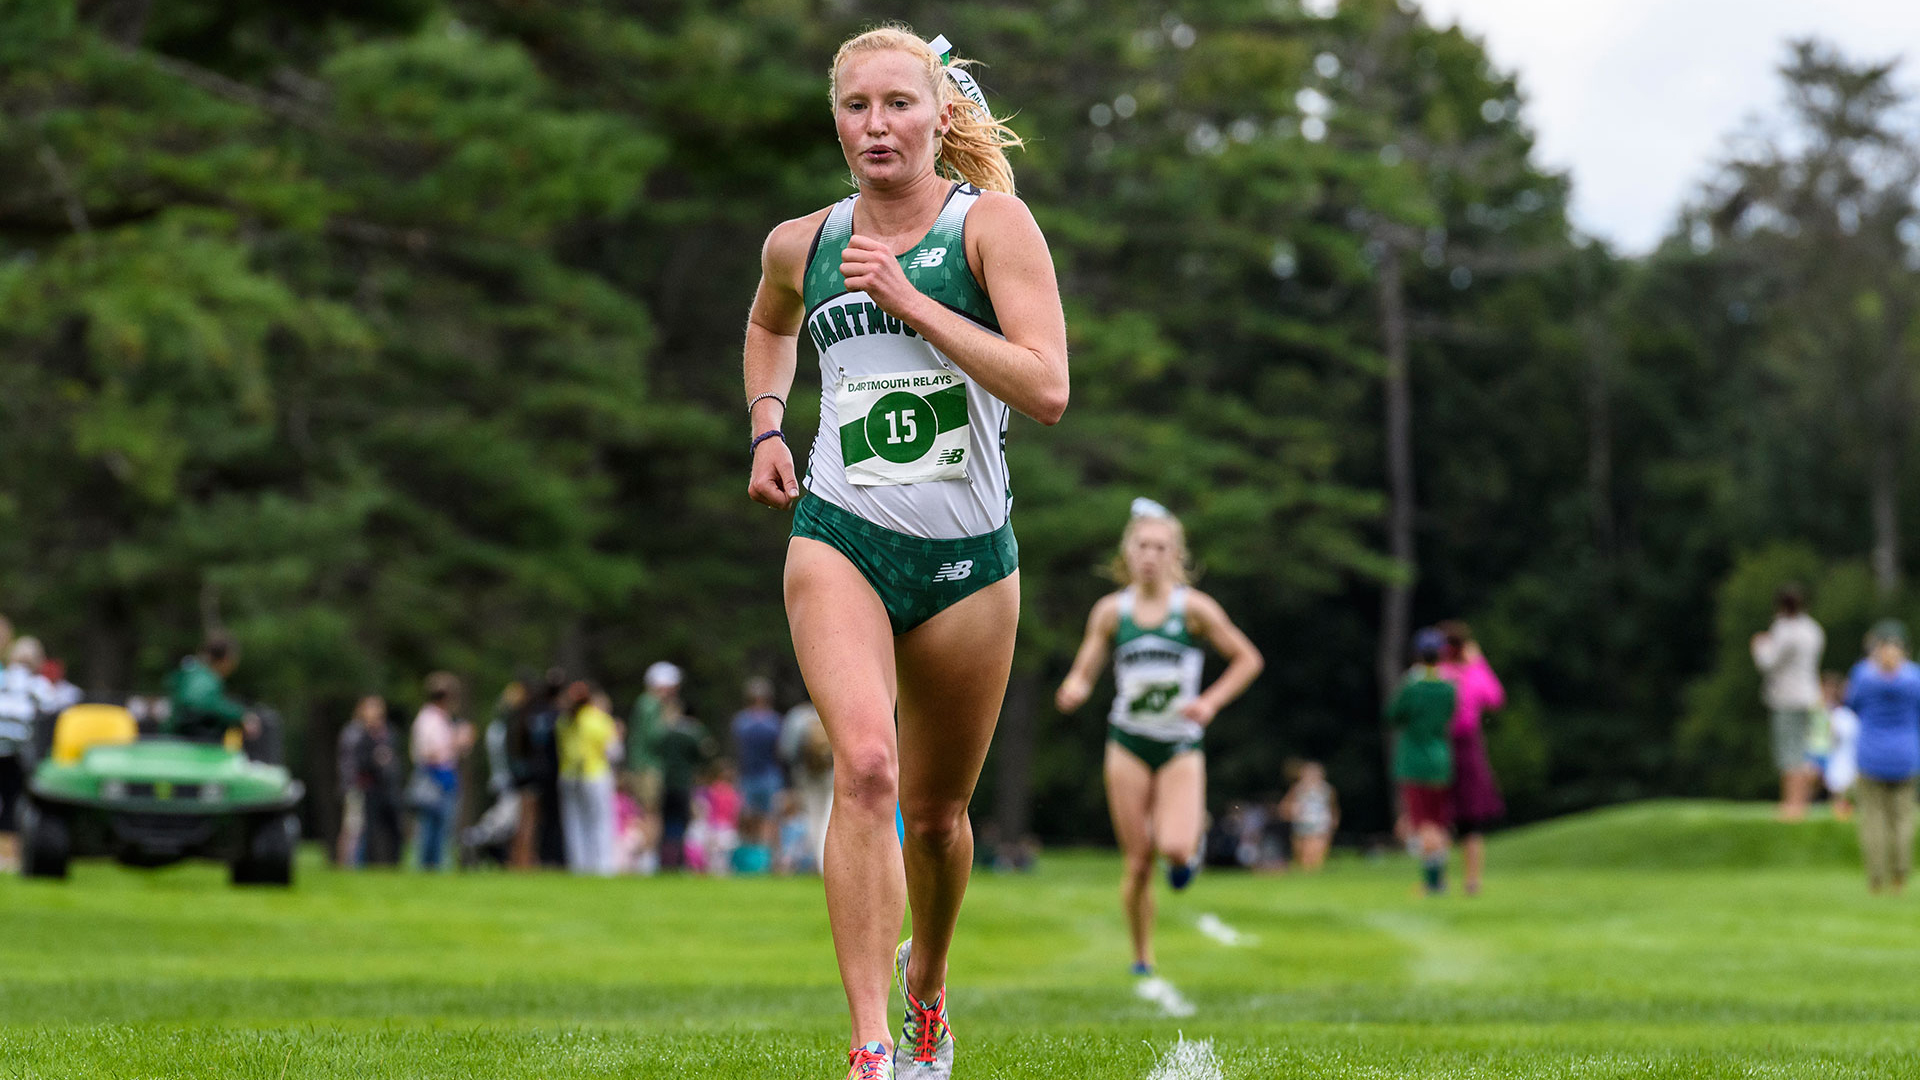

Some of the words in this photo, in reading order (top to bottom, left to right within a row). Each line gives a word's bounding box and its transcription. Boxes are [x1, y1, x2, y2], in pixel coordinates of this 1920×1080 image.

[810, 302, 928, 353] DARTMO
[848, 378, 910, 392] DARTMOUTH
[913, 375, 952, 387] RELAYS
[885, 409, 917, 444] 15
